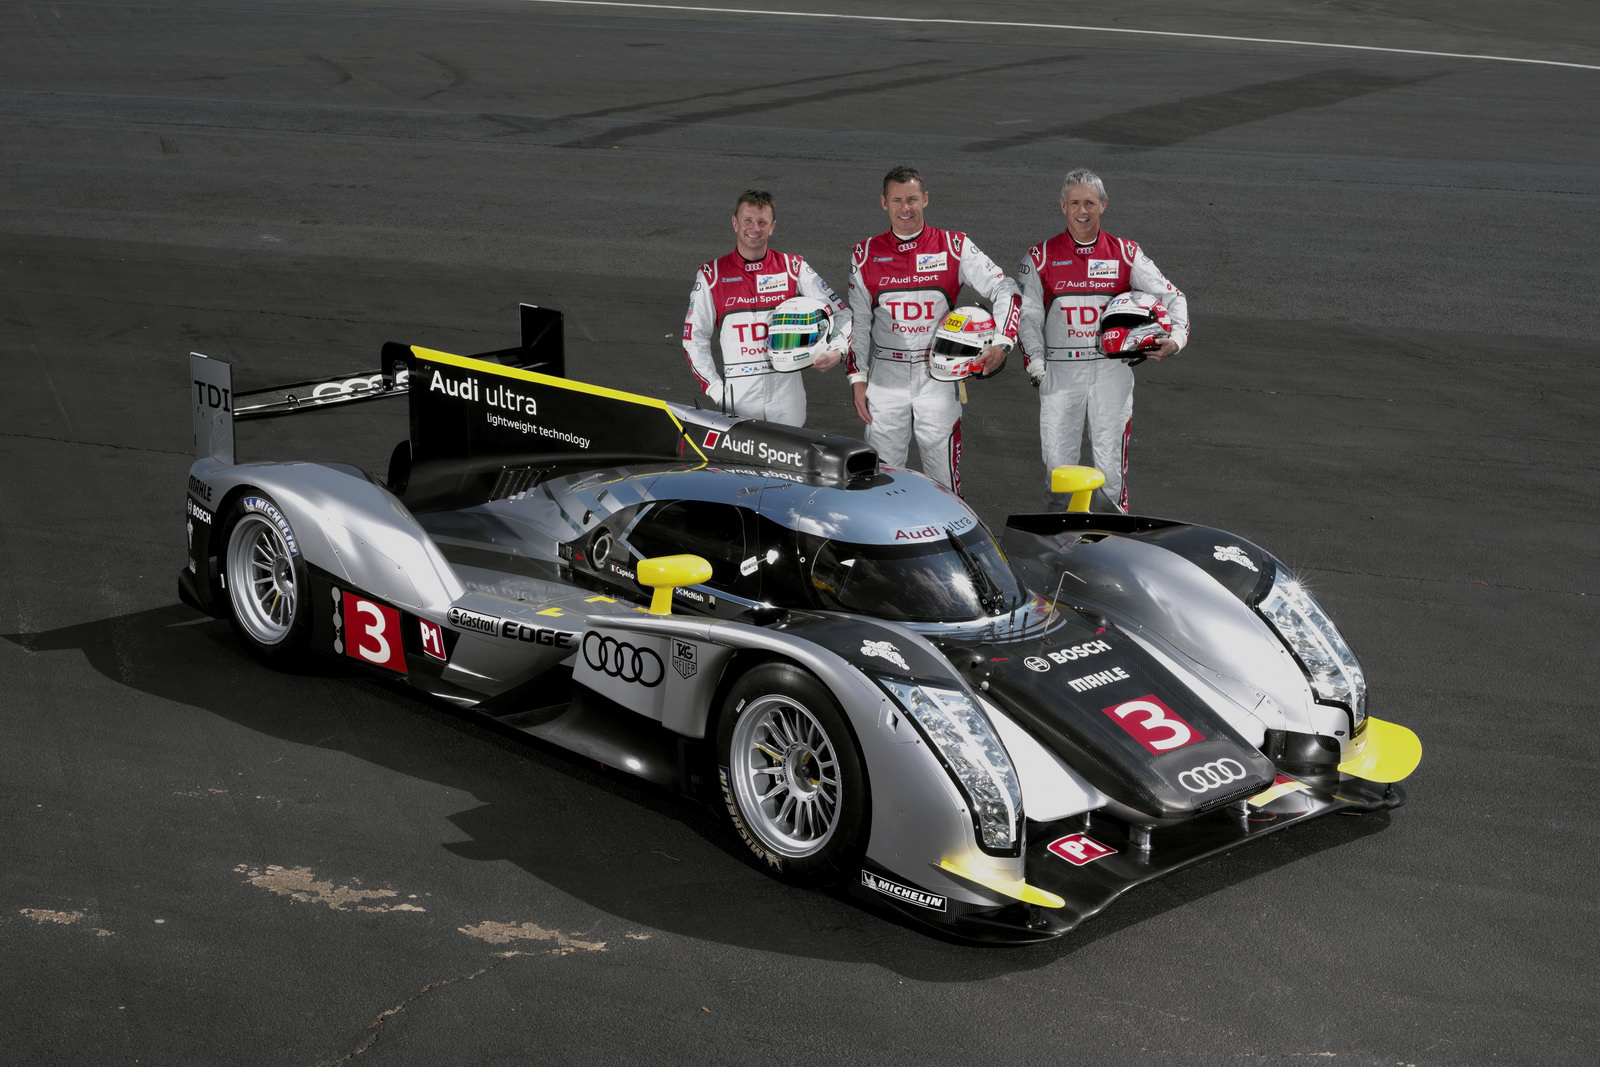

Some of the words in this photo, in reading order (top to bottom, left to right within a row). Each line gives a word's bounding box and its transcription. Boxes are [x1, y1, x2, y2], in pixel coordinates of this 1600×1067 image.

[890, 276, 911, 284] Audi
[913, 274, 939, 284] Sport
[1066, 280, 1087, 288] Audi
[1089, 280, 1115, 289] Sport
[737, 296, 758, 304] Audi
[760, 294, 786, 303] Sport
[886, 302, 934, 320] TDI
[892, 323, 932, 333] Power
[1060, 306, 1106, 326] TD
[732, 322, 769, 343] TD
[1067, 329, 1102, 338] Powe
[741, 346, 769, 355] Pow
[194, 380, 230, 413] TDI
[430, 370, 479, 402] Audi
[486, 385, 537, 416] ultra
[487, 412, 538, 434] lightweight
[539, 426, 591, 449] technology
[721, 434, 754, 456] Audi
[758, 442, 804, 467] Sport
[188, 474, 212, 502] MAHLE
[192, 504, 212, 524] BOSCH
[255, 499, 298, 554] MICHELIN
[895, 526, 940, 540] Audi
[942, 516, 972, 533] ultra
[683, 589, 704, 603] McNish
[356, 600, 391, 664] 3
[420, 621, 440, 654] P1
[460, 612, 495, 633] Castrol
[502, 620, 574, 650] EDGE
[676, 642, 694, 660] TAG
[1047, 640, 1113, 664] BOSCH
[674, 660, 696, 677] HEUER
[1068, 666, 1131, 693] MAHLE
[1113, 700, 1191, 751] 3
[719, 768, 765, 860] MICHELIN
[1059, 837, 1108, 860] P1
[878, 880, 943, 907] MICHELIN
